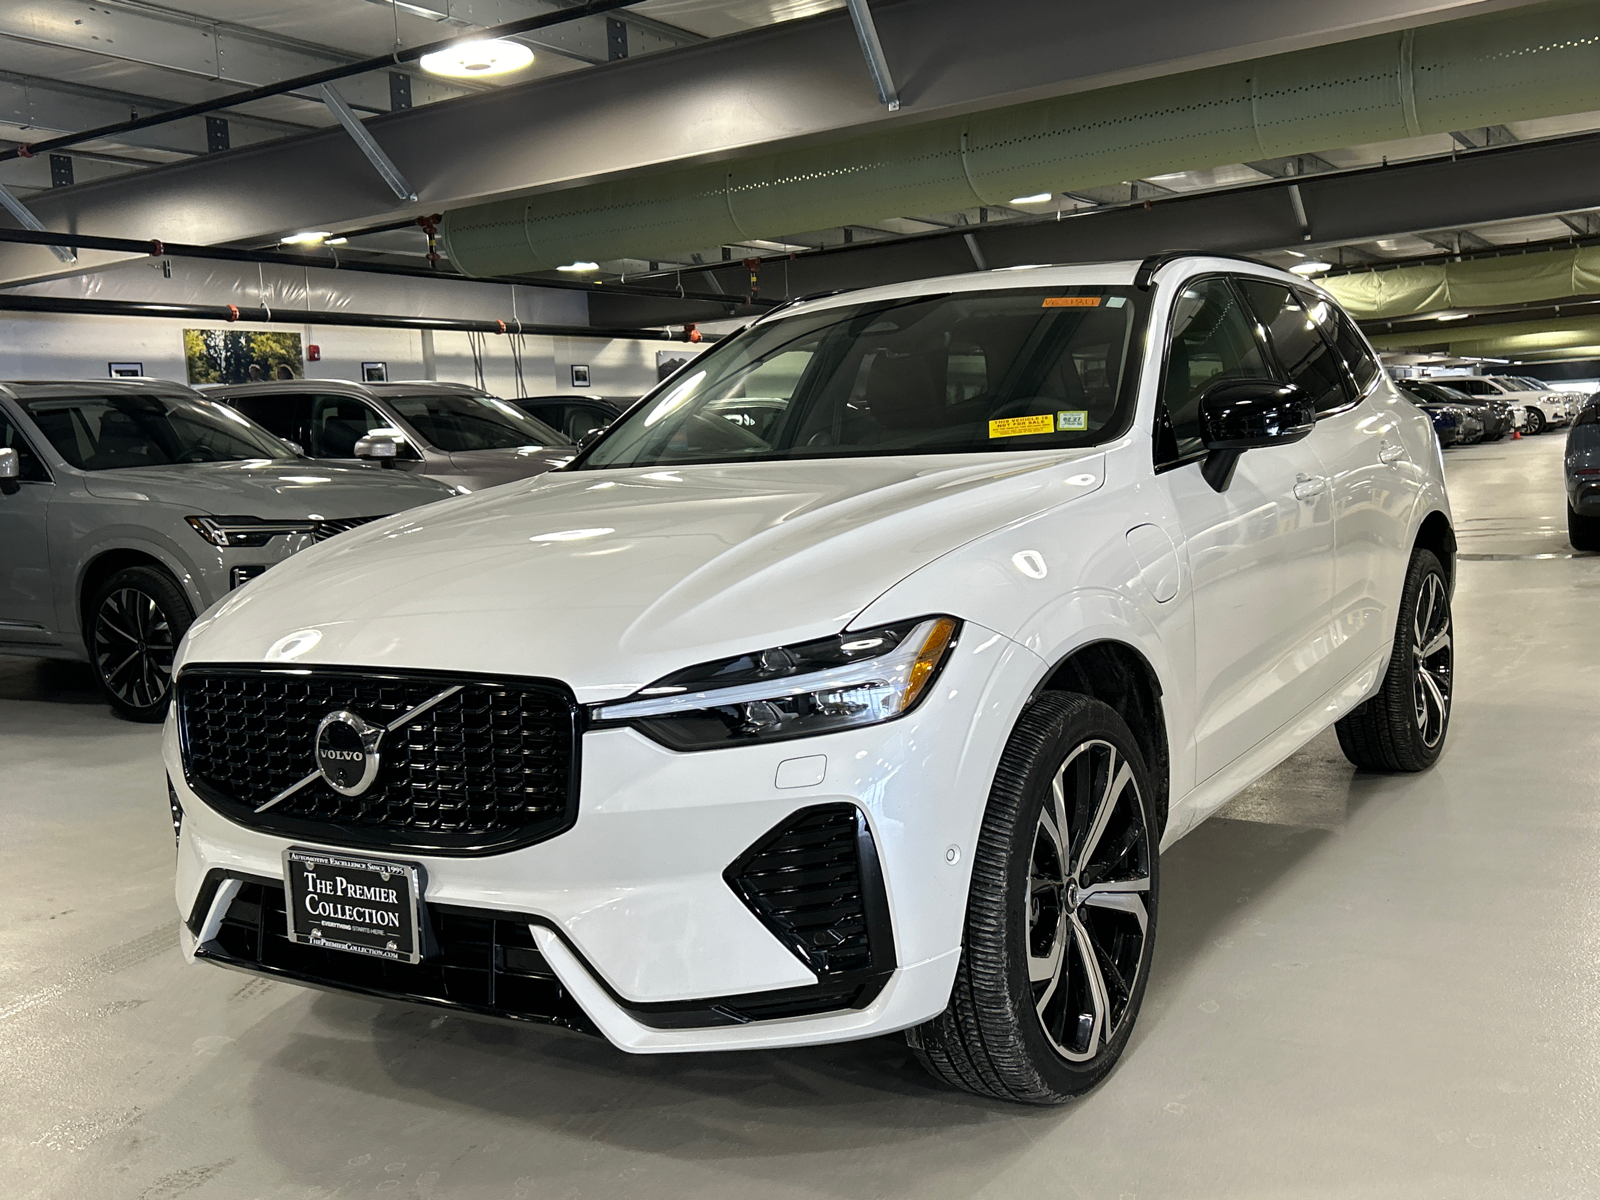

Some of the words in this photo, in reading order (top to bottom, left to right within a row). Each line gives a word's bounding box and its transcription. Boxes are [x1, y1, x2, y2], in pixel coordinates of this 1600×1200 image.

[320, 749, 363, 761] VOLVO
[387, 865, 404, 875] 1995
[335, 876, 399, 904] PREMIER
[305, 893, 400, 927] COLLECTION
[321, 920, 352, 931] EVERYTHING
